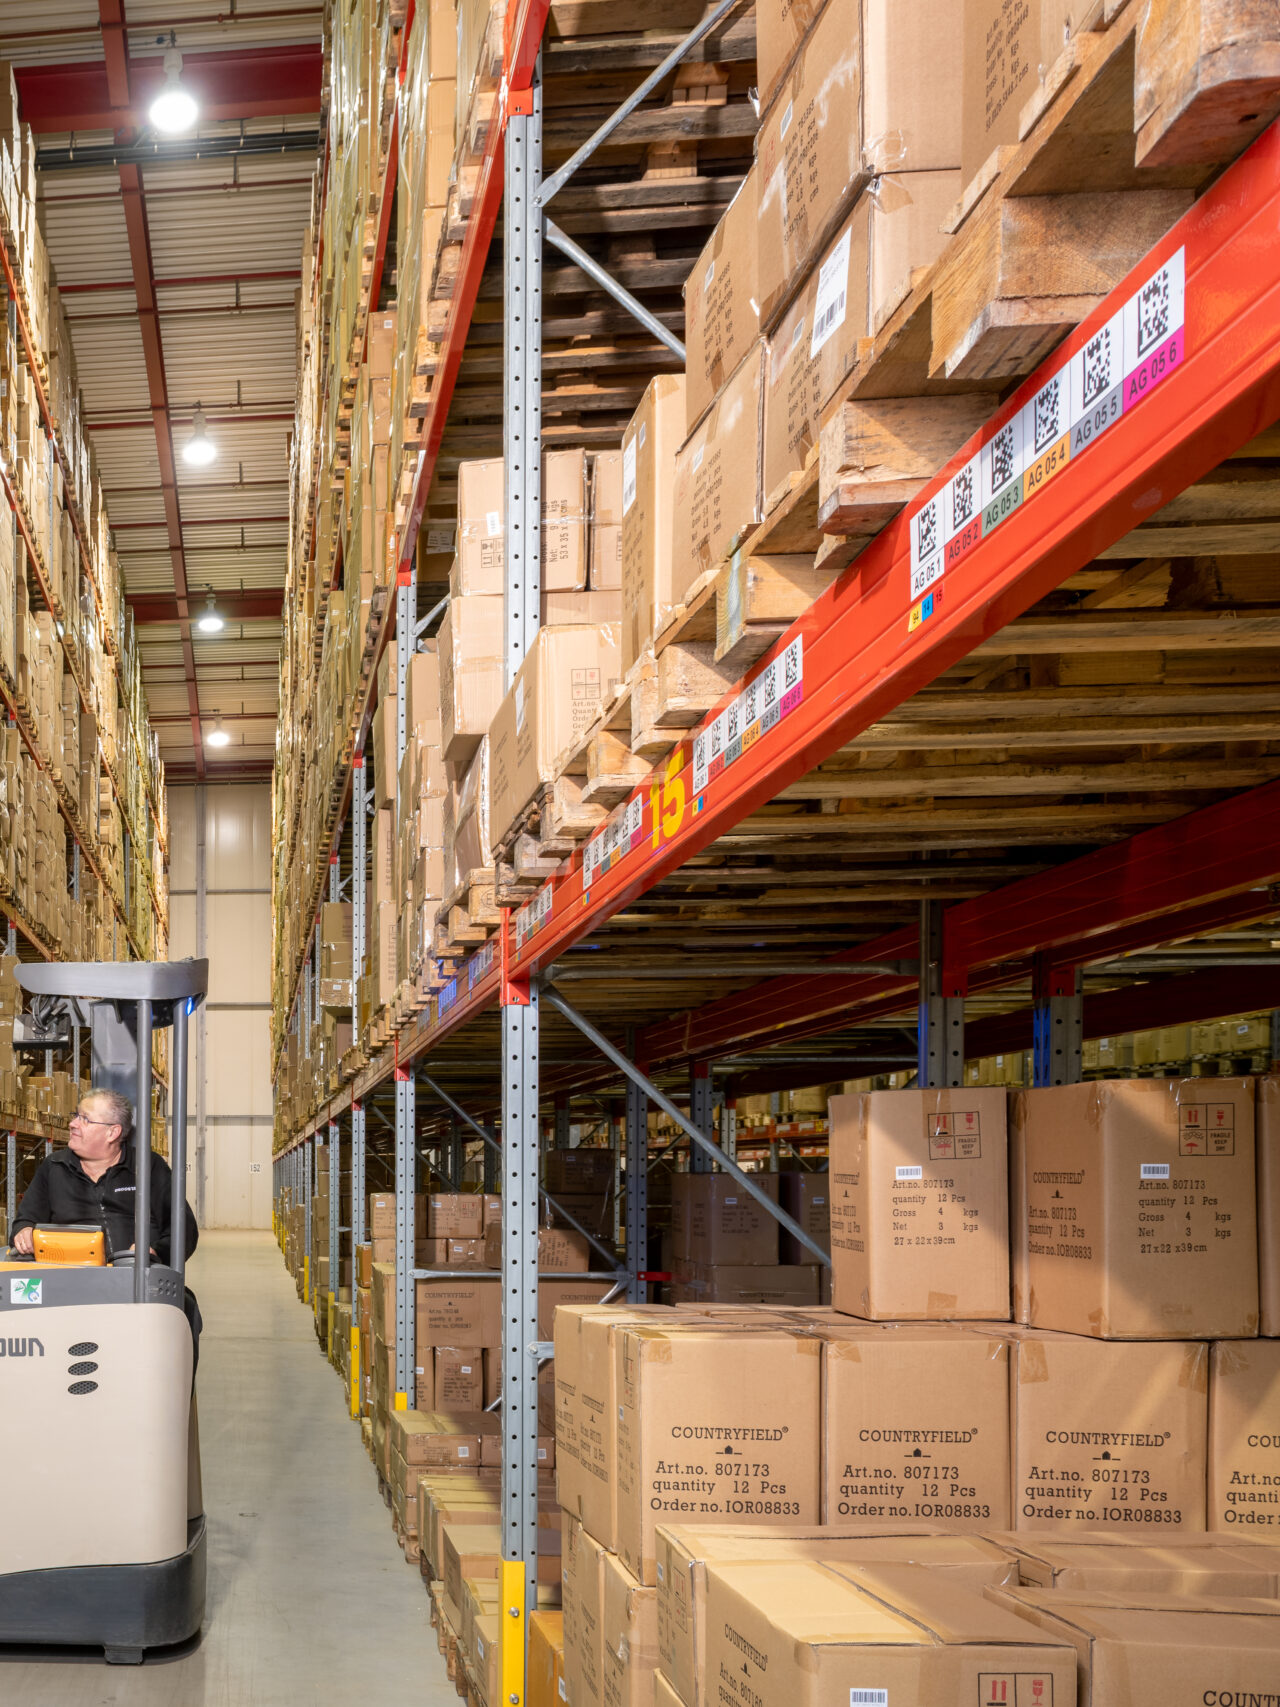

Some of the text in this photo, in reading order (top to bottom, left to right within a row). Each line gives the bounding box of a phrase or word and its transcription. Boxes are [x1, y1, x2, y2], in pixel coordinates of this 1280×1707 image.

[1129, 341, 1177, 400] AG 05 6
[1075, 395, 1117, 449] AG 05 5
[1028, 443, 1065, 492] AG 05 4
[986, 486, 1019, 530] AG 05 3
[949, 523, 978, 562] AG 05 2
[914, 556, 940, 592] AG 05 1
[649, 748, 685, 849] 15
[891, 1179, 955, 1189] Art.no. 807173
[1138, 1180, 1206, 1190] Art.no. 807173
[1138, 1196, 1219, 1208] quantity 12 Pcs
[1138, 1212, 1232, 1224] Gross 4 kgs
[1059, 1224, 1085, 1238] 12 Pcs
[1138, 1228, 1232, 1240] Net 3 kgs
[656, 1462, 770, 1477] Art.no. 807173
[842, 1465, 960, 1480] Art.no. 807173
[1028, 1466, 1150, 1484] Art.no. 807173
[652, 1479, 787, 1495] quantity 12 Pcs
[840, 1482, 976, 1499] quantity 12 Pcs
[1025, 1486, 1168, 1502] quantity 12 Pcs
[650, 1497, 800, 1515] Order no. IOR08833
[838, 1502, 990, 1518] Order no. IOR08833
[1023, 1504, 1182, 1523] Order no. IOR08833
[1224, 1509, 1274, 1525] Order
